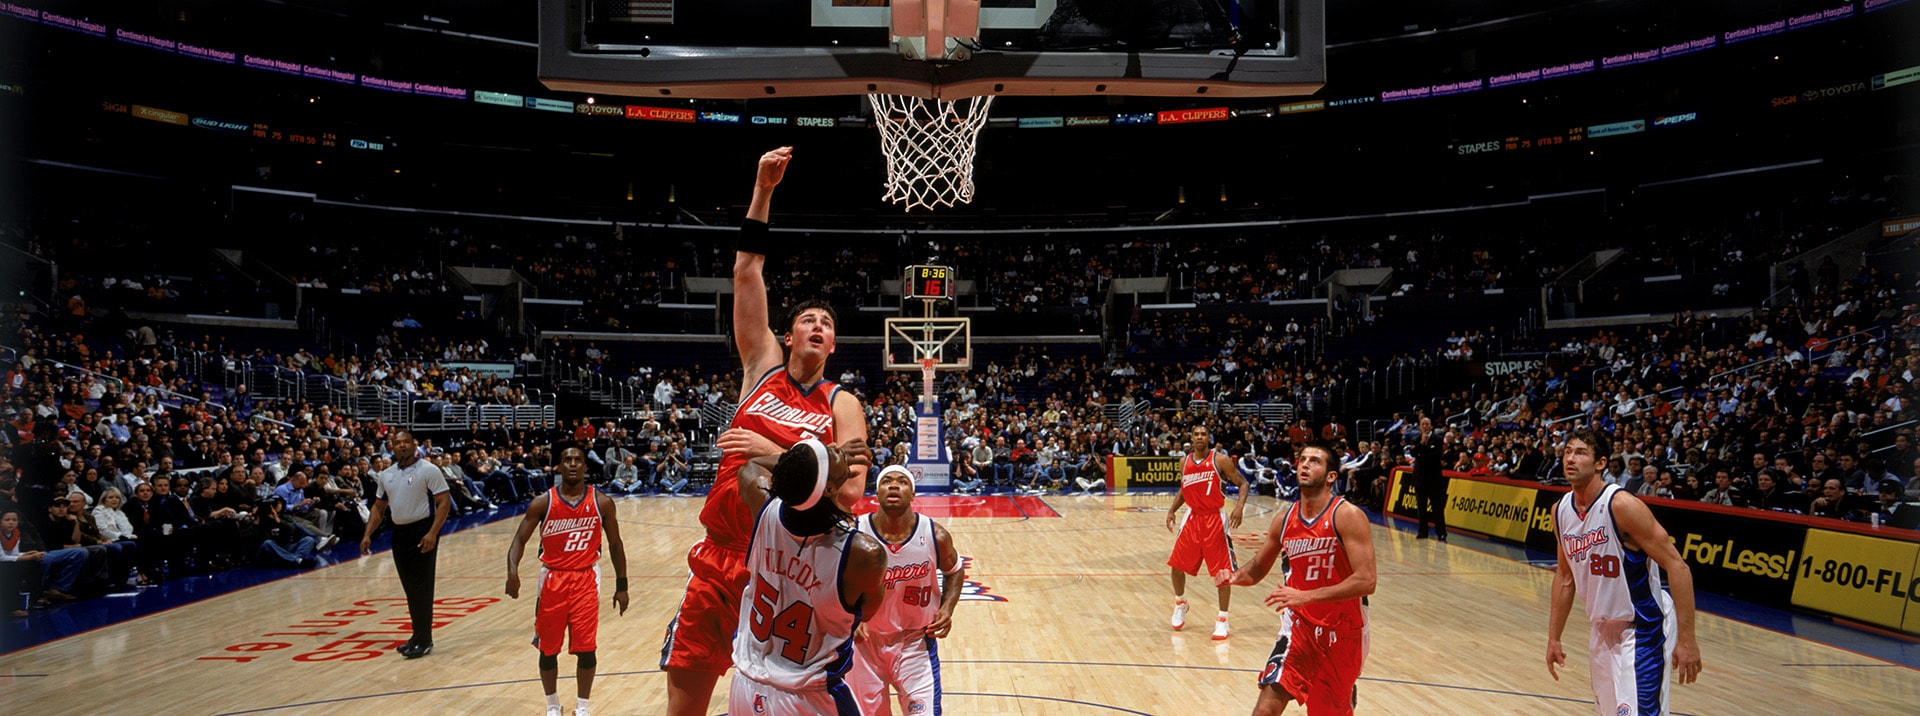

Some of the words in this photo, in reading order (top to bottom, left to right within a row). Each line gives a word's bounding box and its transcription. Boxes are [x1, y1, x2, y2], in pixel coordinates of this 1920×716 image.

[8, 3, 38, 17] Hospital
[1788, 12, 1822, 26] Centinela
[1823, 4, 1854, 18] Hospital
[42, 11, 75, 26] Centinela
[76, 19, 106, 32] Hospital
[116, 28, 148, 42] Centinela
[149, 35, 175, 48] Hospital
[1725, 28, 1755, 40] Centinela
[1756, 20, 1785, 32] Hospital
[178, 42, 208, 56] Centinela
[208, 48, 235, 60] Hospital
[1661, 42, 1689, 54] Centinela
[1690, 36, 1716, 48] Hospital
[244, 54, 274, 67] Centinela
[275, 60, 301, 71] Hospital
[1602, 54, 1632, 64] Centinela
[1633, 48, 1659, 60] Hospital
[304, 65, 331, 76] Centinela
[332, 70, 355, 80] Hospital
[1542, 65, 1569, 75] Centinela
[1570, 60, 1594, 71] Hospital
[361, 75, 386, 86] Centinela
[388, 80, 412, 90] Hospital
[1490, 74, 1516, 84] Centinela
[1516, 69, 1540, 80] Hospital
[414, 83, 442, 93] Centinela
[443, 86, 467, 96] Hospital
[1382, 90, 1407, 98] Centinela
[1407, 86, 1430, 96] Hospital
[1432, 83, 1458, 92] Centinela
[1459, 79, 1482, 89] Hospital
[1820, 82, 1866, 98] TOYOTA
[590, 106, 623, 115] TOYOTA
[628, 108, 646, 117] L.A.
[649, 108, 694, 121] CLIPPERS
[711, 112, 739, 122] PEPSI
[1160, 113, 1178, 122] L.A.
[1182, 110, 1226, 120] CLIPPERS
[1664, 112, 1696, 125] PEPSI
[194, 117, 218, 127] BUD
[218, 121, 249, 131] LIGHT
[797, 116, 834, 127] STAPLES
[1458, 140, 1501, 155] STAPLES
[922, 268, 945, 278] 8:36
[925, 280, 941, 296] 16
[745, 392, 832, 434] CHARLOTTE
[1135, 472, 1182, 482] LIQUIDA
[1206, 481, 1212, 496] 1
[1452, 496, 1529, 523] 1-800-FLOORING
[542, 516, 599, 536] CHARLOTTE
[564, 530, 593, 552] 22
[1284, 536, 1338, 557] CHARLOTTE
[1563, 526, 1609, 562] Clippers
[1682, 532, 1722, 565] For
[1722, 539, 1796, 581] Less!
[765, 548, 822, 596] LCOX
[1305, 554, 1335, 581] 24
[1590, 554, 1620, 578] 20
[903, 586, 932, 608] 50
[750, 572, 814, 665] 54
